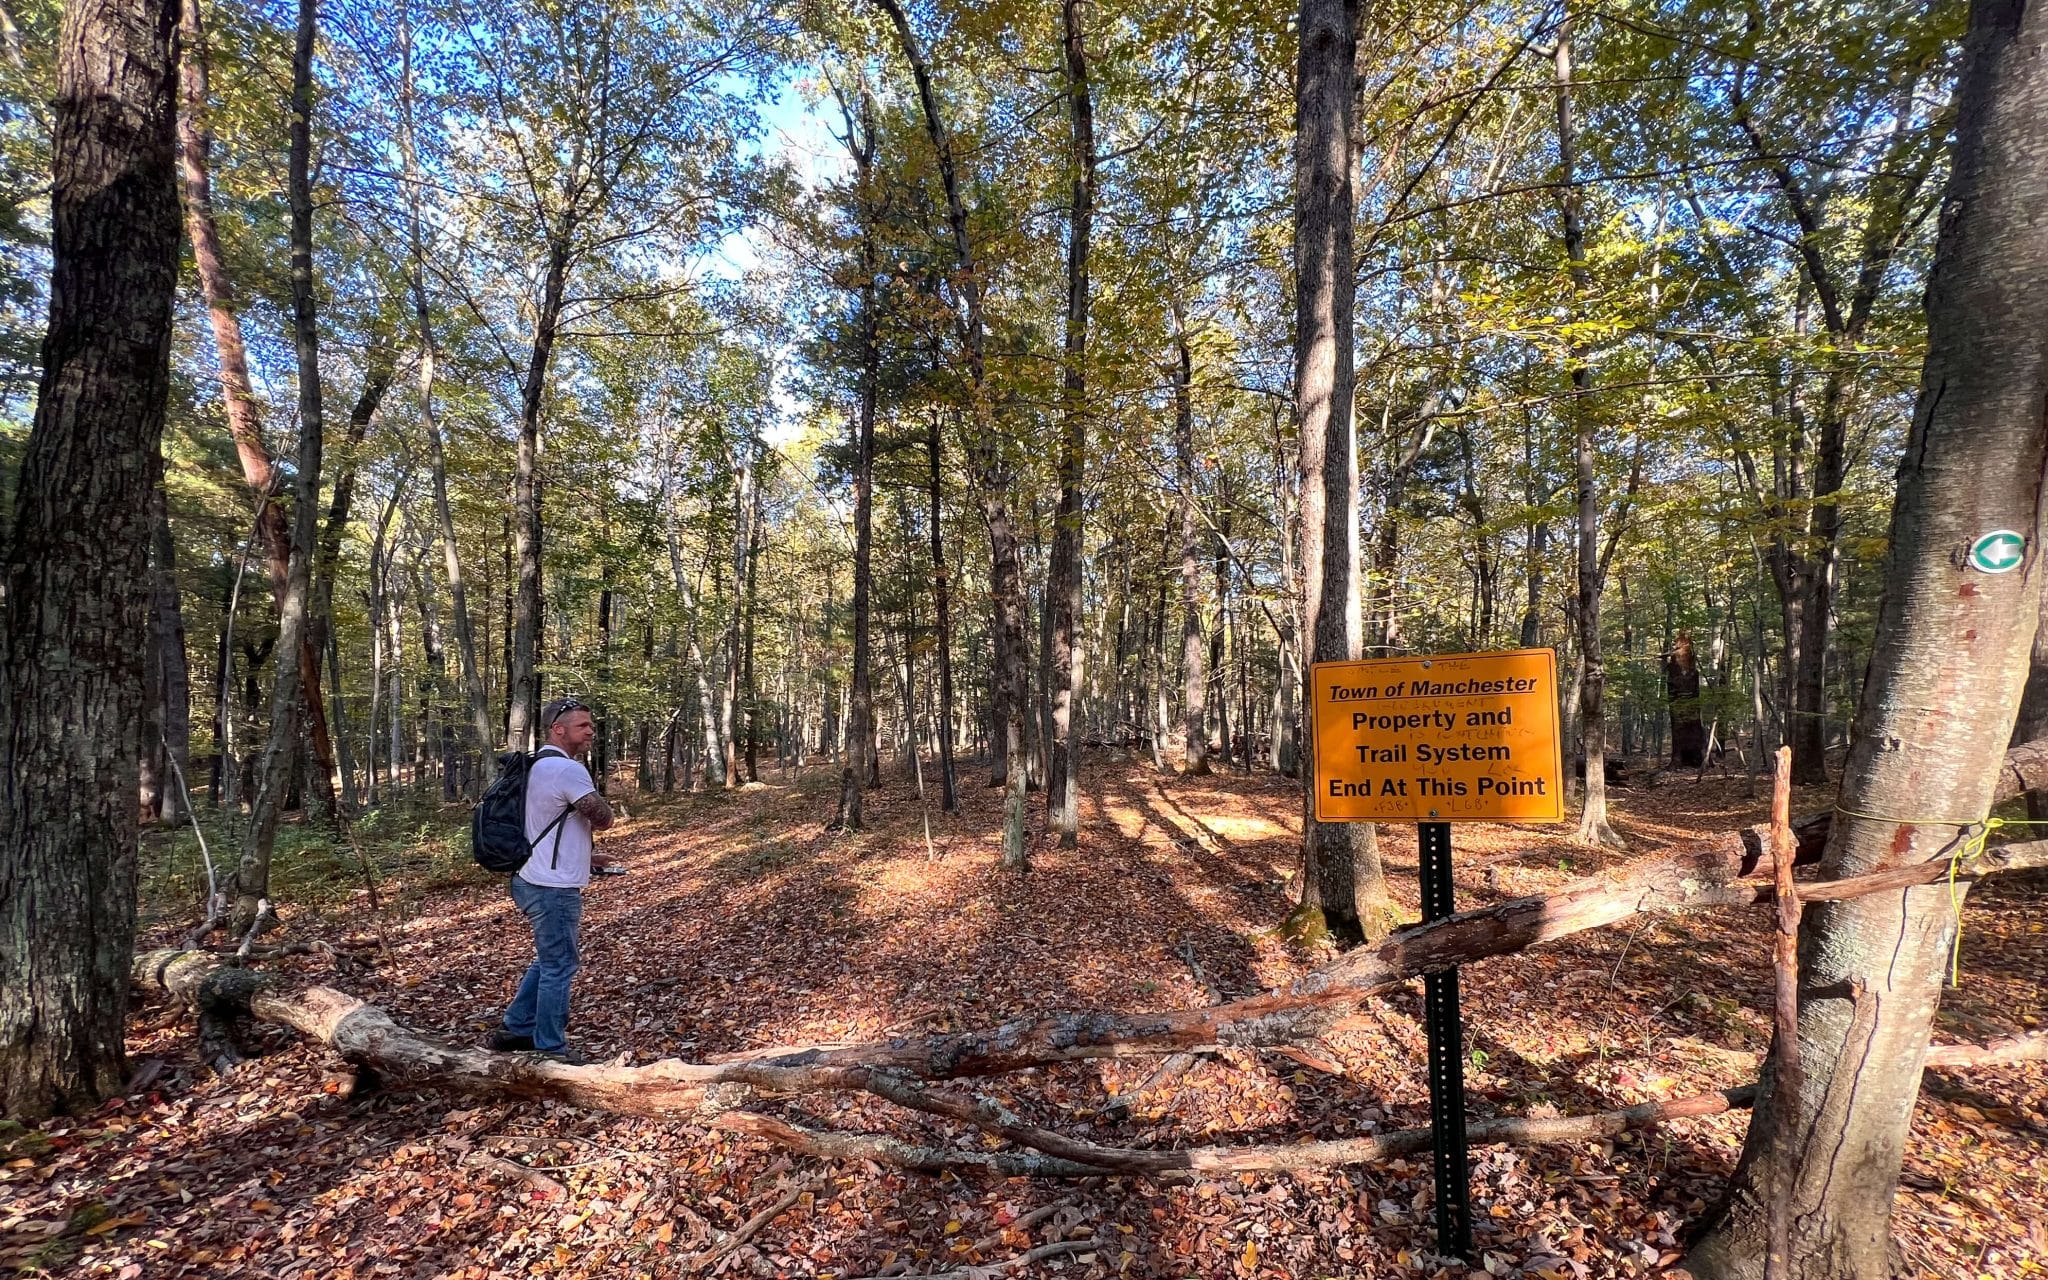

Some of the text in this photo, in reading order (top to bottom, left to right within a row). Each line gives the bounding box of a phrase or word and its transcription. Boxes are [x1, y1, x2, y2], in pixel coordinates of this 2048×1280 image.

[1330, 676, 1537, 700] Town of Manchester
[1352, 706, 1512, 732] Property and
[1355, 743, 1510, 766] Trail System
[1329, 776, 1546, 797] End At This Point
